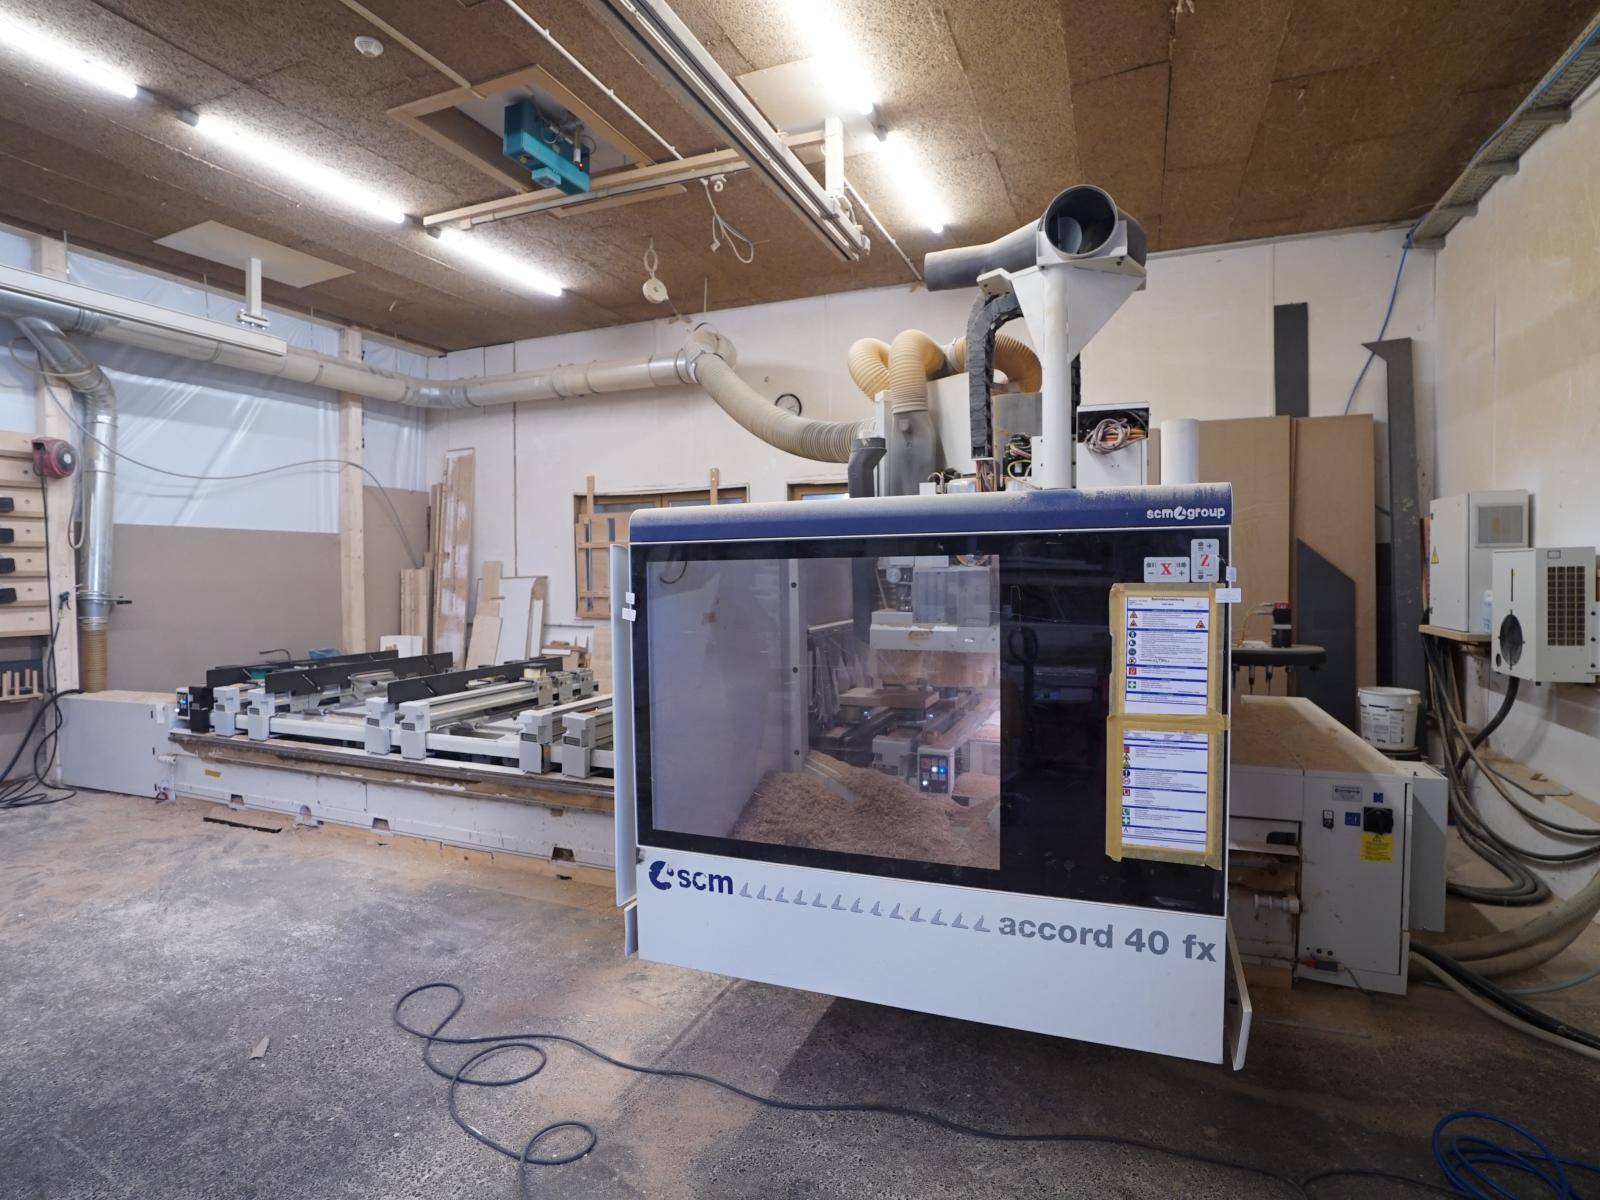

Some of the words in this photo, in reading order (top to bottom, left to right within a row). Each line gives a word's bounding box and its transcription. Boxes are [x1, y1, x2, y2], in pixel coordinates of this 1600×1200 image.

[1187, 507, 1226, 520] group
[1160, 562, 1172, 576] X
[677, 869, 734, 895] scm
[998, 916, 1113, 949] accord
[1124, 928, 1170, 956] 40
[1182, 934, 1217, 963] fx
